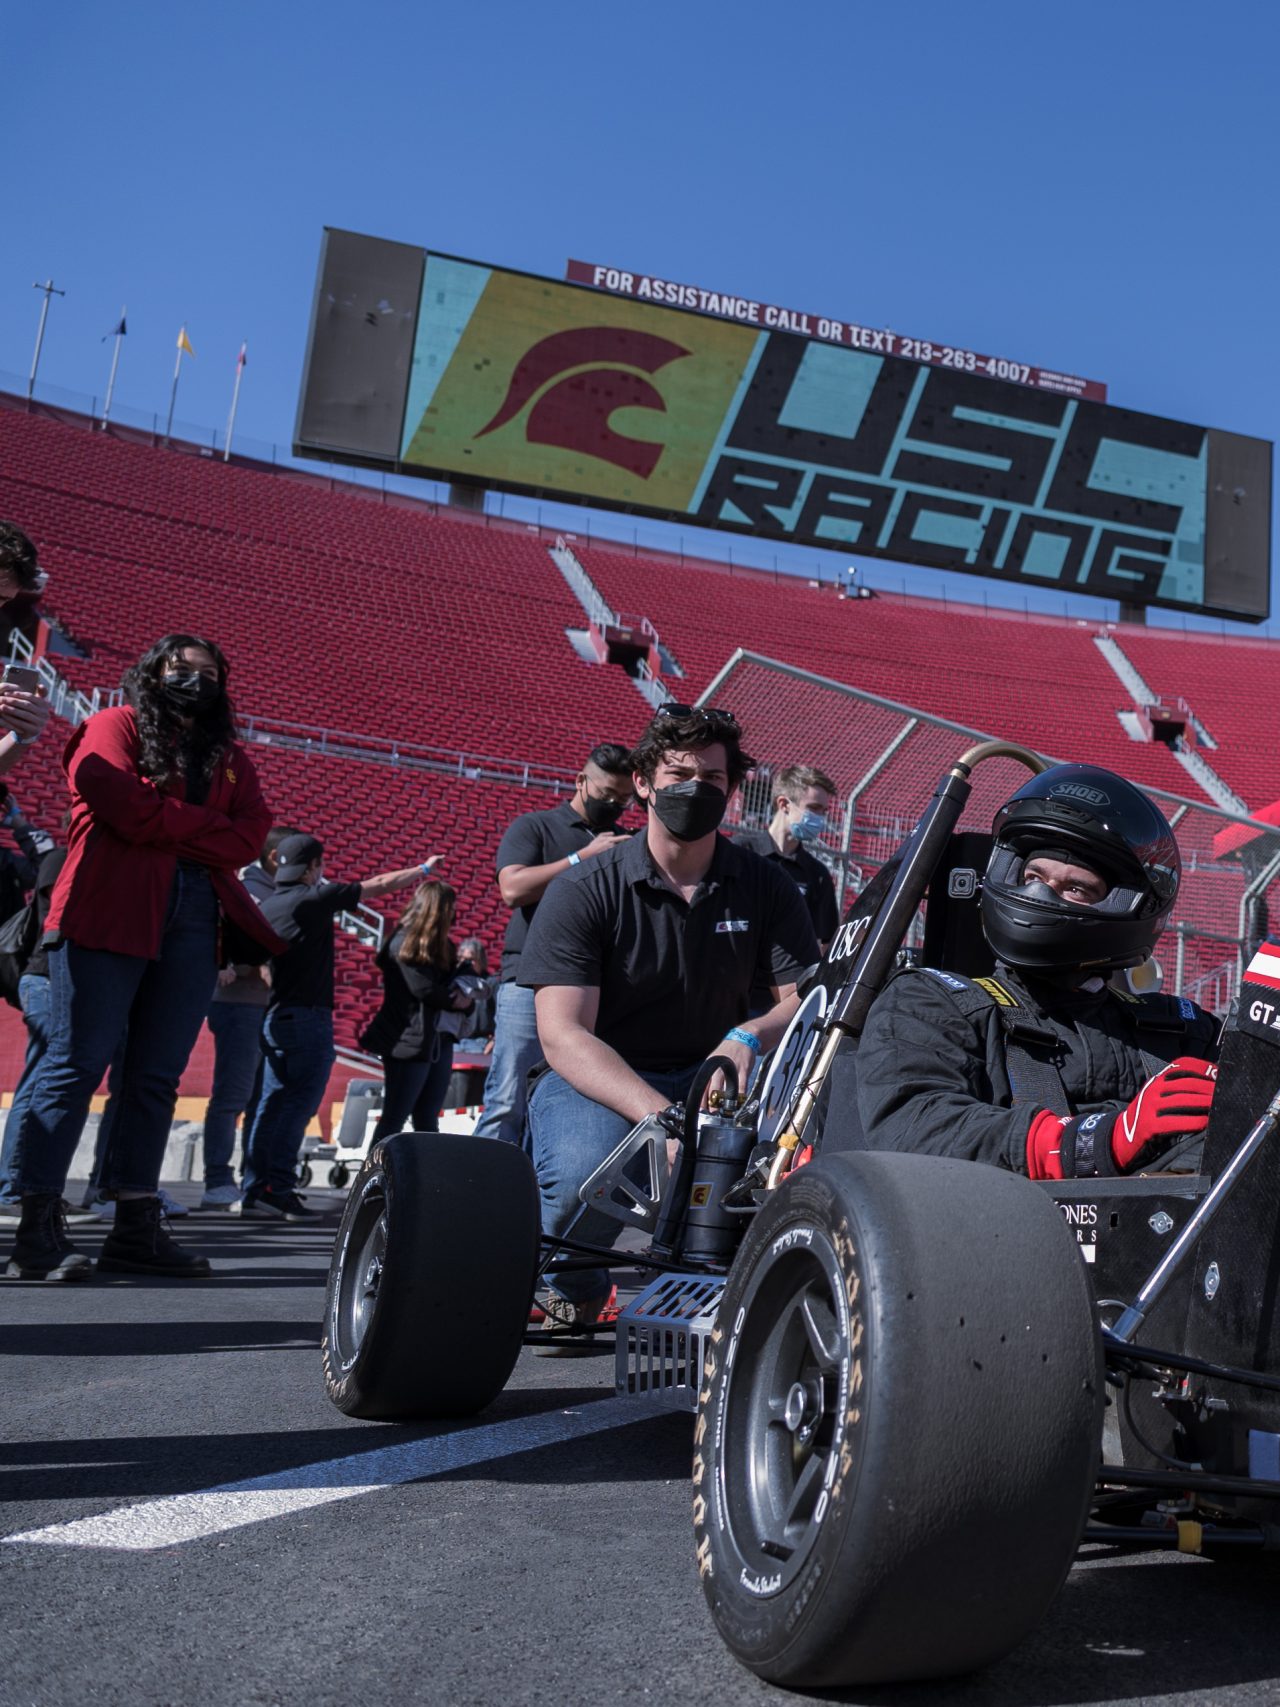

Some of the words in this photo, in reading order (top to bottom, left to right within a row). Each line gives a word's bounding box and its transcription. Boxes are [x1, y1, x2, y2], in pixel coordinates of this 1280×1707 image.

[593, 266, 634, 293] FOR
[637, 277, 760, 322] ASSISTANCE
[764, 306, 812, 334] CALL
[817, 318, 842, 342] OR
[849, 325, 896, 353] TEXT
[900, 338, 1035, 385] 213-263-4007.
[725, 332, 1206, 537] USC
[702, 454, 1174, 597] RACING
[1056, 783, 1105, 803] SHOEI
[828, 915, 873, 963] USC
[1249, 1000, 1275, 1025] GT
